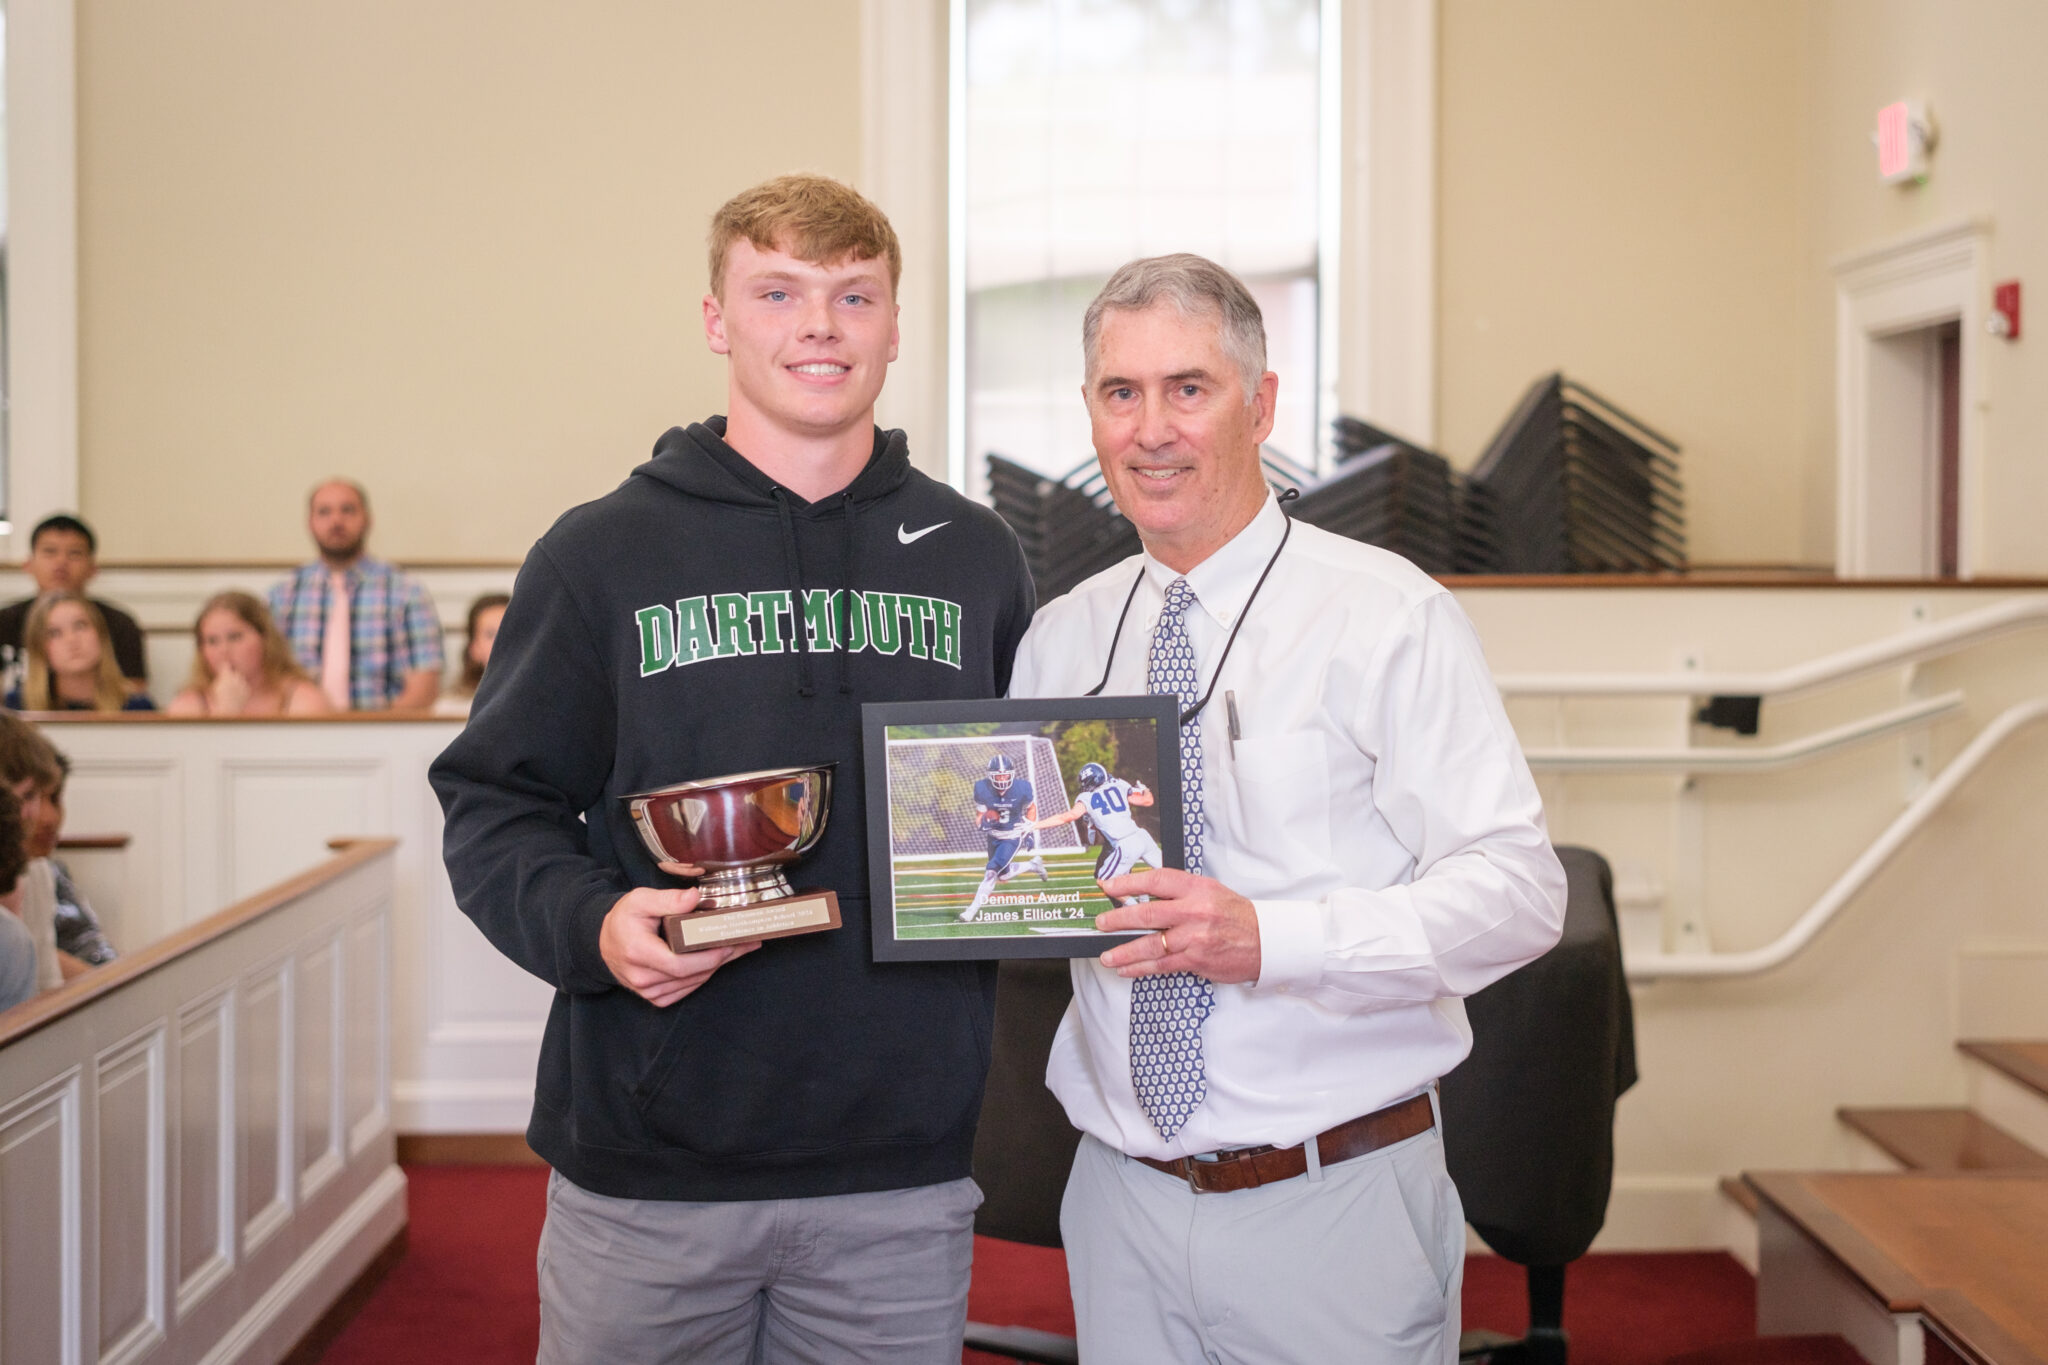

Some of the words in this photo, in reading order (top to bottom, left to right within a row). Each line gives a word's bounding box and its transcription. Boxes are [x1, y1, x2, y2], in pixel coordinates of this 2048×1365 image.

[635, 589, 962, 678] DARTMOUTH
[1090, 786, 1126, 816] 40
[980, 894, 1035, 905] Denman
[1037, 891, 1080, 904] Award
[976, 909, 1019, 922] James
[1023, 908, 1063, 920] Elliott
[1065, 907, 1085, 919] '24
